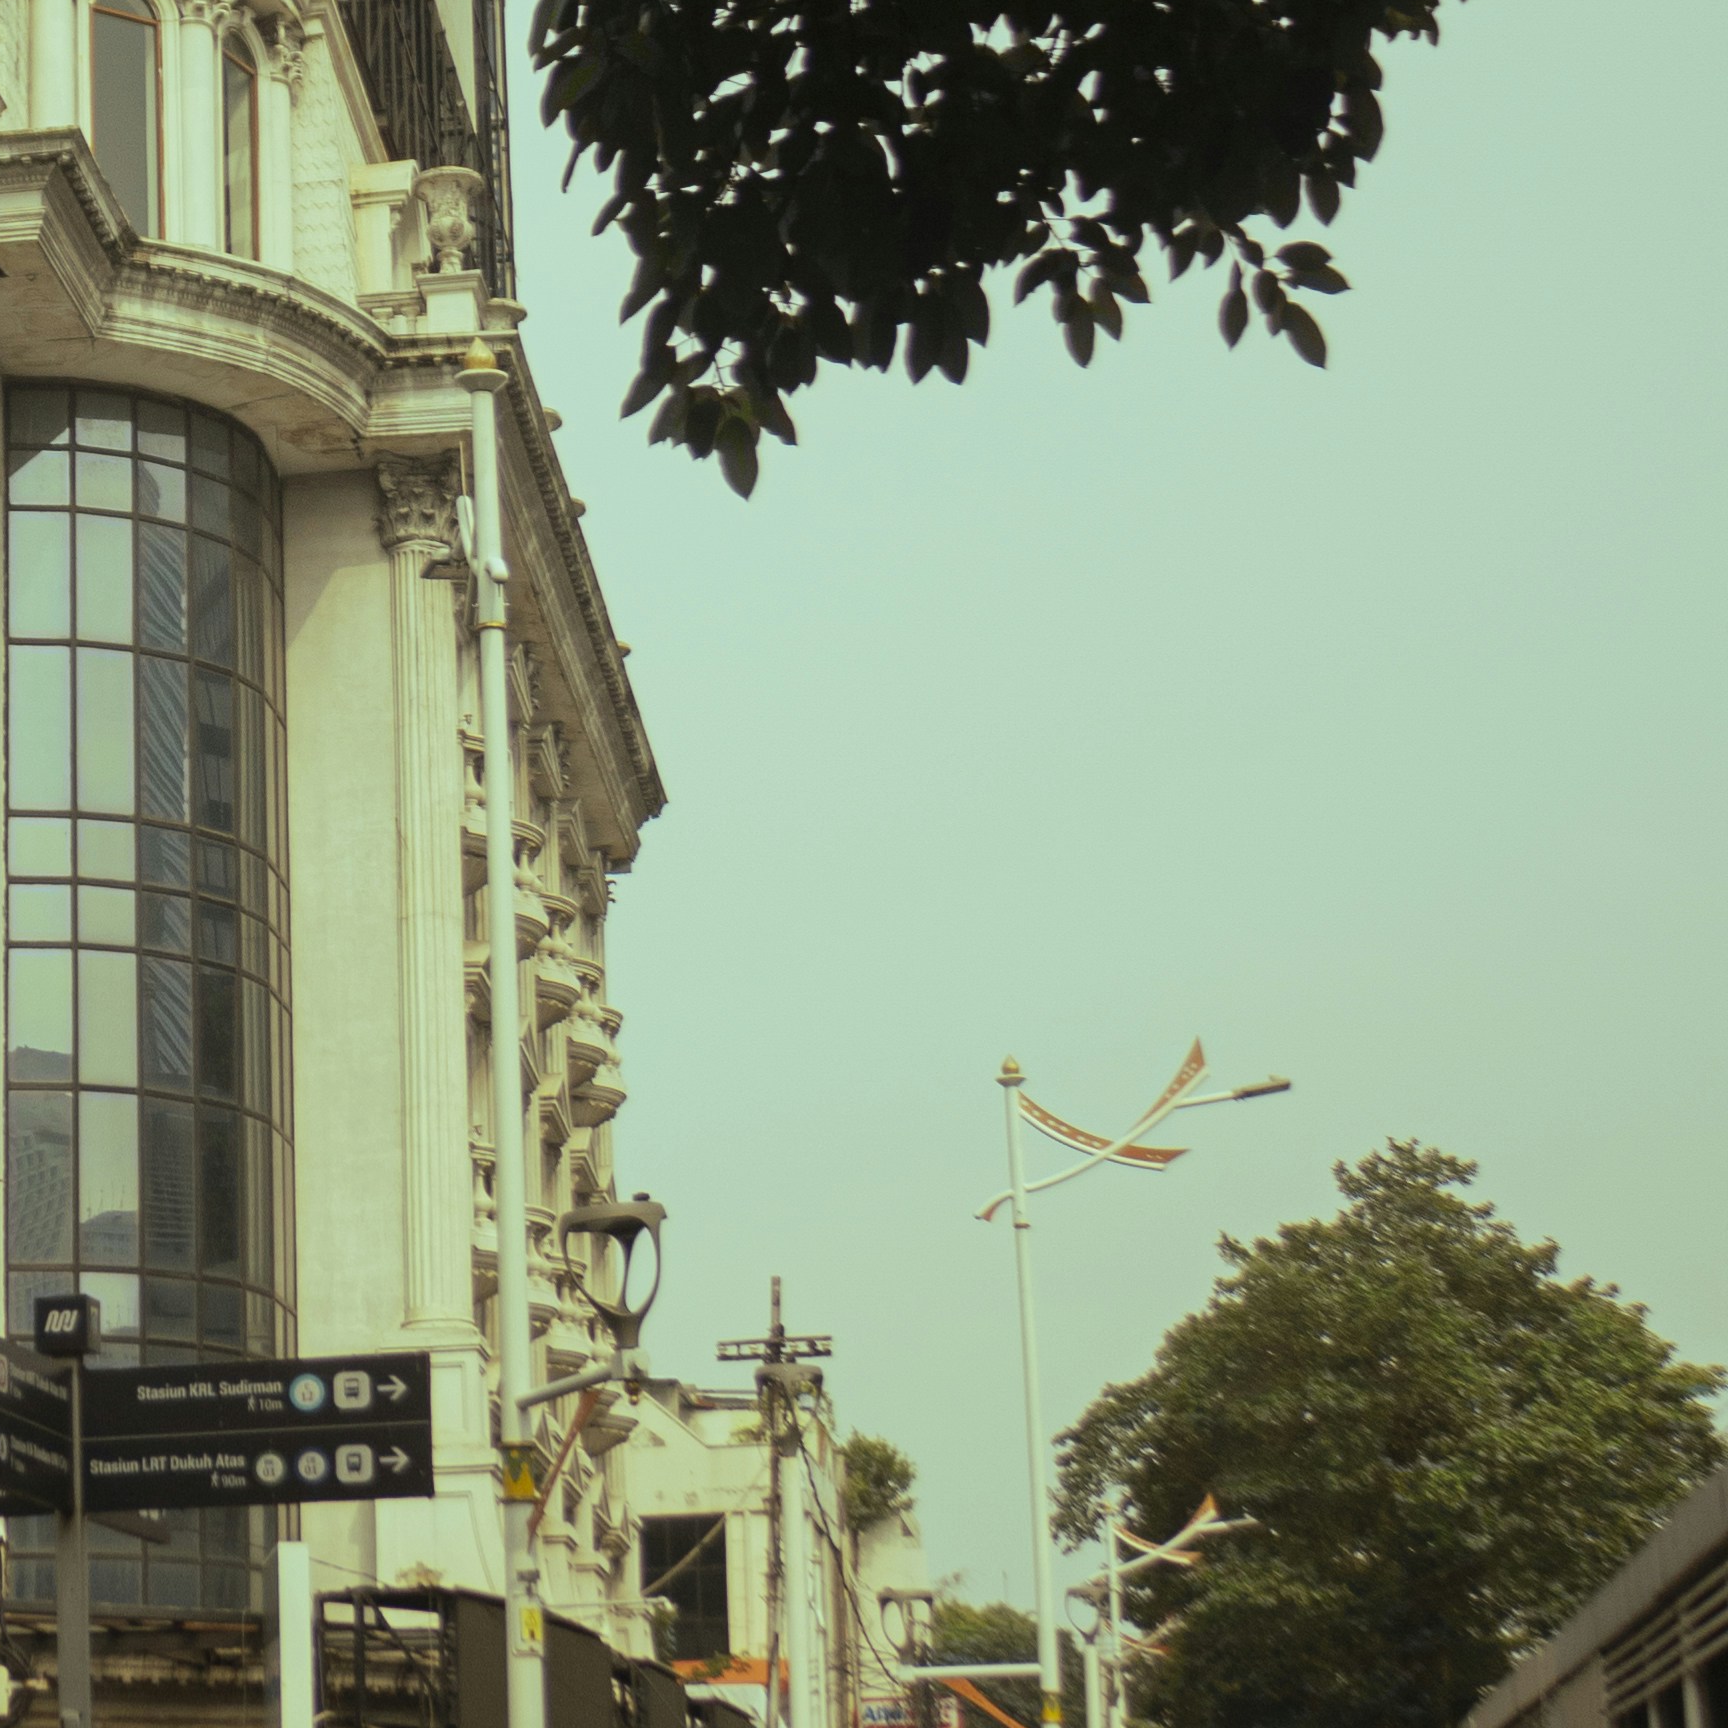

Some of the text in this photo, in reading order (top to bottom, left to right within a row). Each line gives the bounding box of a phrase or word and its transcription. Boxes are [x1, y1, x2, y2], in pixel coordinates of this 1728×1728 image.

[137, 1379, 282, 1401] Stasiun KRL Sudirman
[259, 1399, 283, 1411] 10m
[90, 1453, 245, 1475] Stasiun LRT Dukuh Atas
[221, 1474, 246, 1487] 90m
